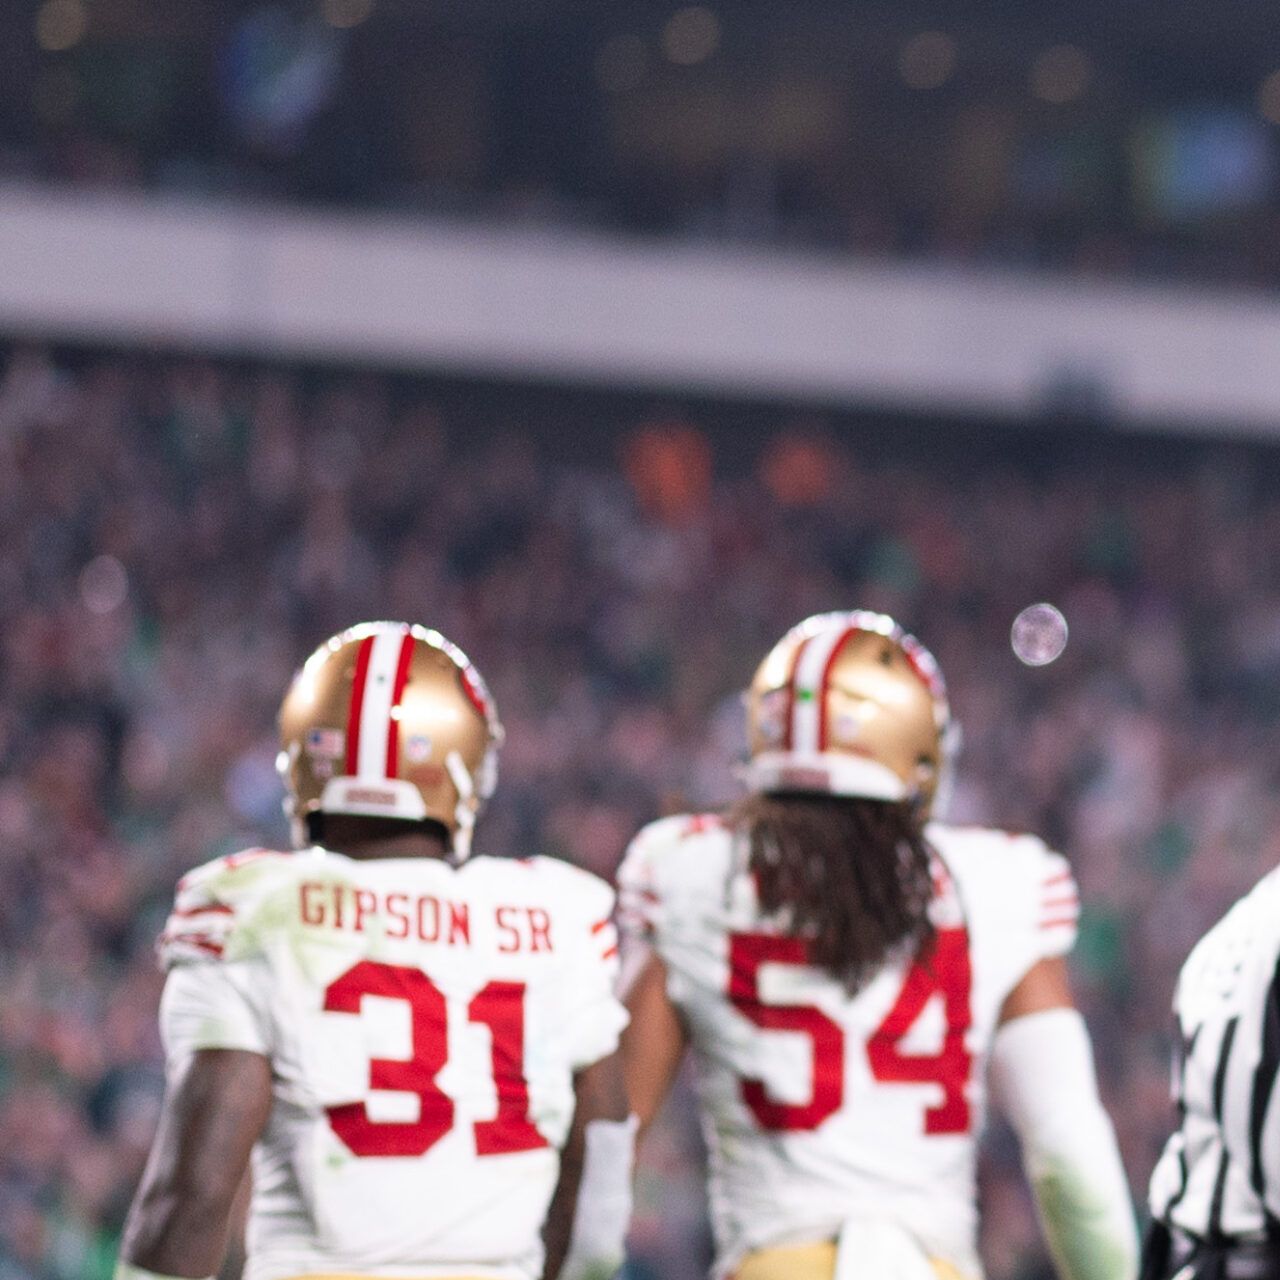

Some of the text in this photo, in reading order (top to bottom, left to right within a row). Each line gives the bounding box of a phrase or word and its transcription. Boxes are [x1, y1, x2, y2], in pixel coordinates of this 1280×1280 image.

[300, 880, 554, 953] GIPSON SR
[323, 958, 551, 1158] 31
[726, 925, 972, 1135] 54
